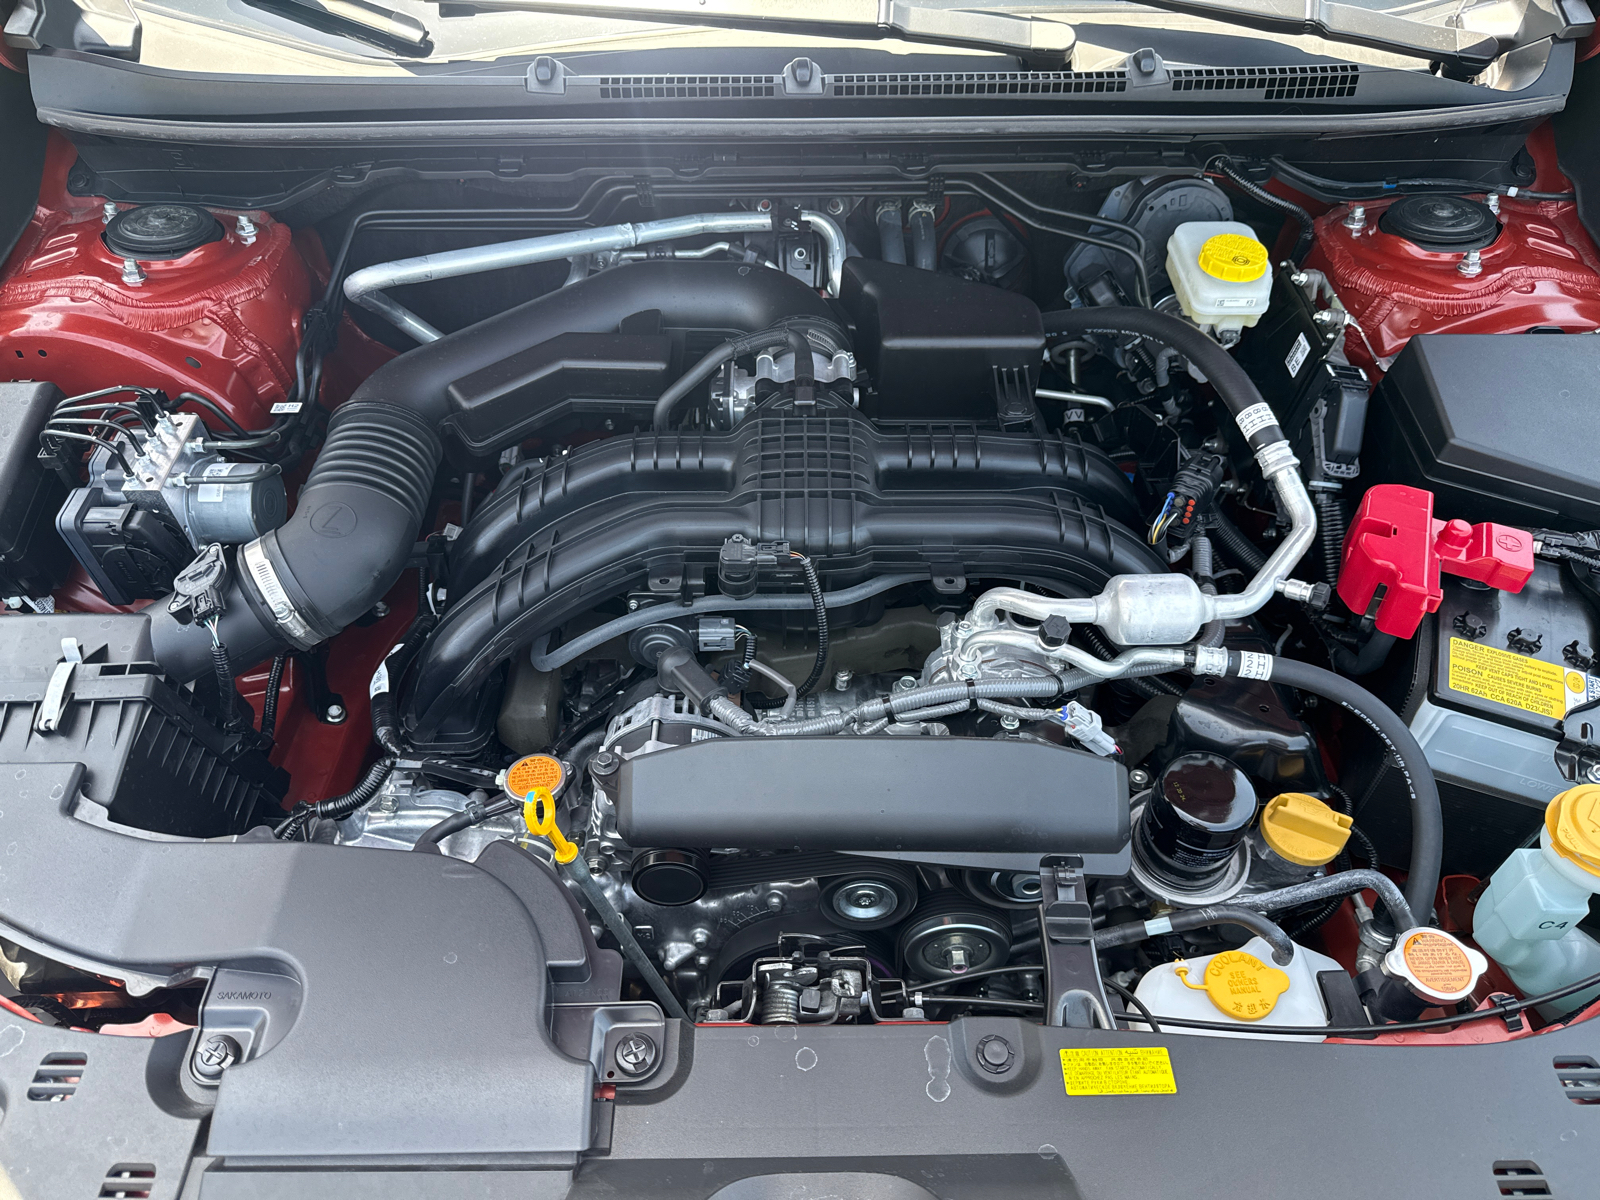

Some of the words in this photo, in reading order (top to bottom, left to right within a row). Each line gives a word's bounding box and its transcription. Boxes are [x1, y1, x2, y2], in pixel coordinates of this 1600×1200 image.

[1452, 638, 1484, 652] DANGER
[1486, 648, 1511, 659] EXPLOSIVE
[1512, 654, 1528, 664] GASES
[1452, 663, 1482, 677] POISON
[1486, 673, 1506, 683] CAUSES
[1506, 678, 1524, 688] SEVERE
[1525, 684, 1541, 693] BURNS
[1475, 664, 1488, 672] KEEP
[1488, 667, 1500, 675] VENT
[1501, 671, 1513, 679] CAPS
[1514, 674, 1527, 683] TIGHT
[1452, 682, 1469, 692] 20HR
[1470, 687, 1487, 697] 62Ah
[1490, 692, 1504, 702] CCA
[1506, 696, 1522, 707] 620A
[1525, 702, 1552, 716] D23(JIS)
[1475, 682, 1487, 691] KEEP
[1487, 686, 1497, 694] OUT
[1505, 691, 1522, 700] REACH
[1530, 697, 1553, 709] CHILDREN
[1538, 920, 1569, 930] C4
[1209, 953, 1267, 977] COOLANT
[1229, 970, 1246, 979] SEE
[1227, 977, 1259, 987] OWNERS
[1229, 986, 1261, 995] MANUAL
[217, 991, 272, 1000] SAKAMOTO
